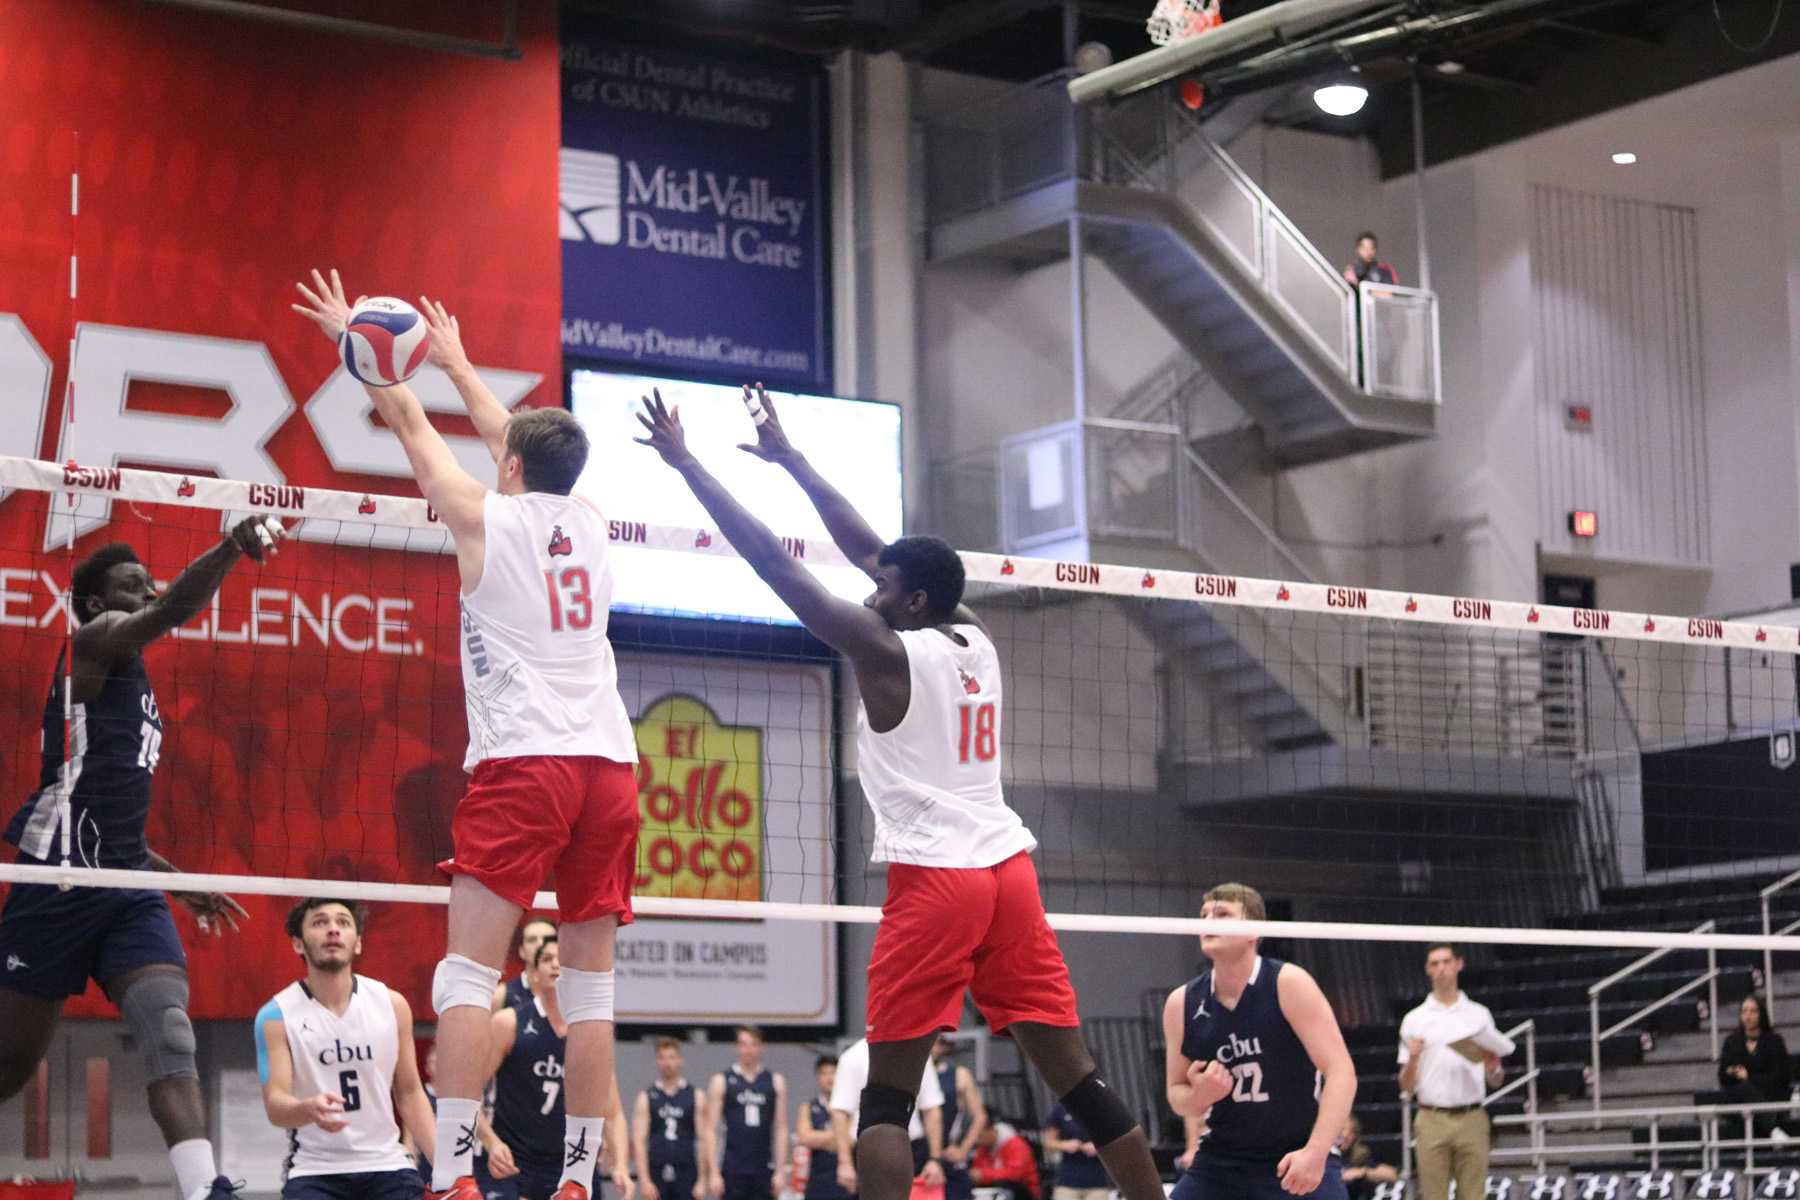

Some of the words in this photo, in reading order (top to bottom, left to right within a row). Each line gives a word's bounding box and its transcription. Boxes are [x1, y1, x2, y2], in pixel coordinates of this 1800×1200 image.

[561, 45, 629, 77] fficial
[635, 54, 706, 89] Dental
[711, 65, 797, 103] Practice
[571, 79, 599, 104] of
[677, 93, 772, 130] Athletics
[626, 160, 805, 236] Mid-Valley
[627, 211, 727, 259] Dental
[731, 226, 803, 269] Care
[561, 317, 810, 372] idValleyDentalCare.com
[0, 312, 545, 556] RS
[62, 465, 122, 492] CSUN
[249, 483, 305, 510] CSUN
[608, 519, 647, 544] SUN
[781, 536, 805, 559] UN
[1056, 562, 1100, 585] CSUN
[1194, 575, 1237, 598] CSUN
[1326, 587, 1367, 610] CSUN
[1453, 599, 1492, 621] CSUN
[1572, 610, 1610, 631] CSUN
[1687, 618, 1724, 640] CSUN
[0, 567, 424, 656] EXLENCE.
[543, 564, 595, 634] 13
[461, 604, 491, 678] SUN
[141, 689, 163, 728] cb
[958, 702, 997, 765] 18
[664, 726, 698, 757] El
[636, 837, 754, 887] oco
[615, 940, 666, 963] CATED
[671, 941, 693, 964] ON
[700, 942, 767, 966] CAMPUS
[319, 1038, 373, 1066] cbu
[1216, 1032, 1263, 1063] cbu
[339, 1070, 361, 1112] 6
[541, 1080, 560, 1115] 7
[1231, 1061, 1270, 1102] 22
